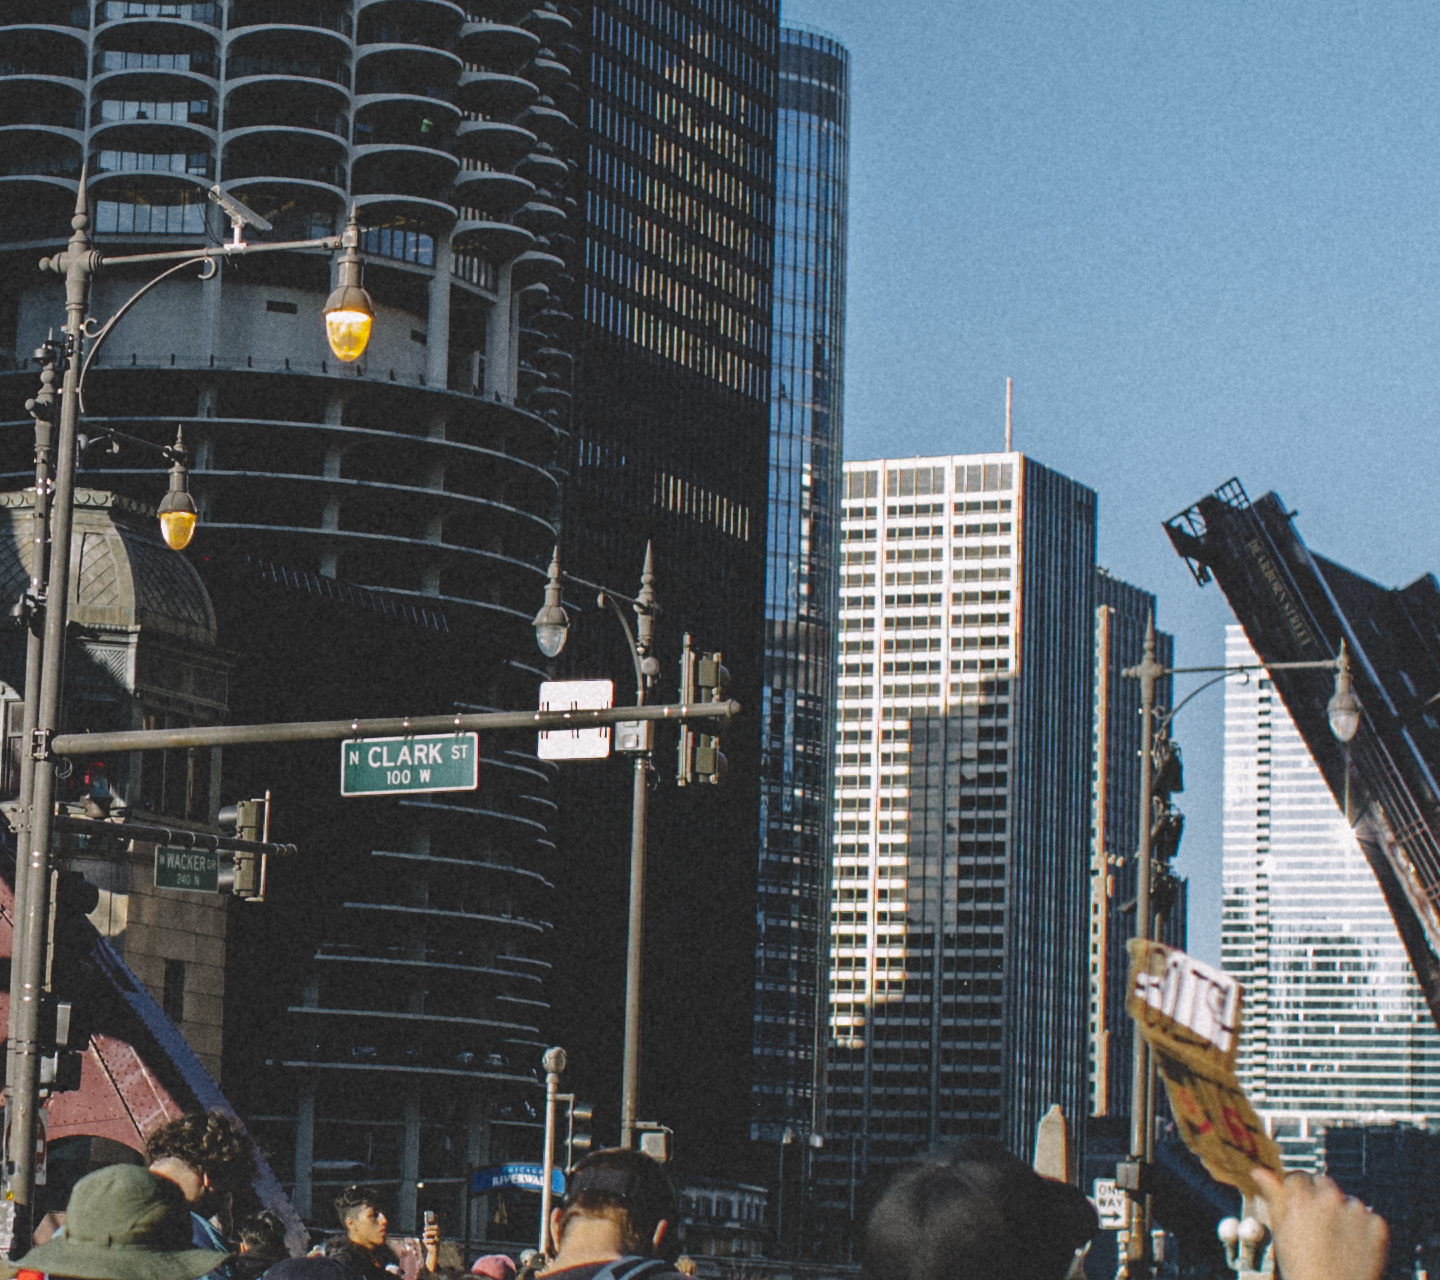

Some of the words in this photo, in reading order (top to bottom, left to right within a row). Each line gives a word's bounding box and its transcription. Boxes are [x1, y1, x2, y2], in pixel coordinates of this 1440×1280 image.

[349, 750, 359, 765] N
[368, 742, 443, 768] CLARK
[451, 744, 469, 760] ST
[386, 769, 411, 785] 100
[419, 768, 431, 783] W
[166, 852, 206, 871] WACKER
[207, 858, 216, 870] DR
[176, 873, 191, 885] 240
[194, 874, 200, 886] N
[492, 1173, 544, 1188] RIVERWAL
[1098, 1197, 1124, 1208] WAY
